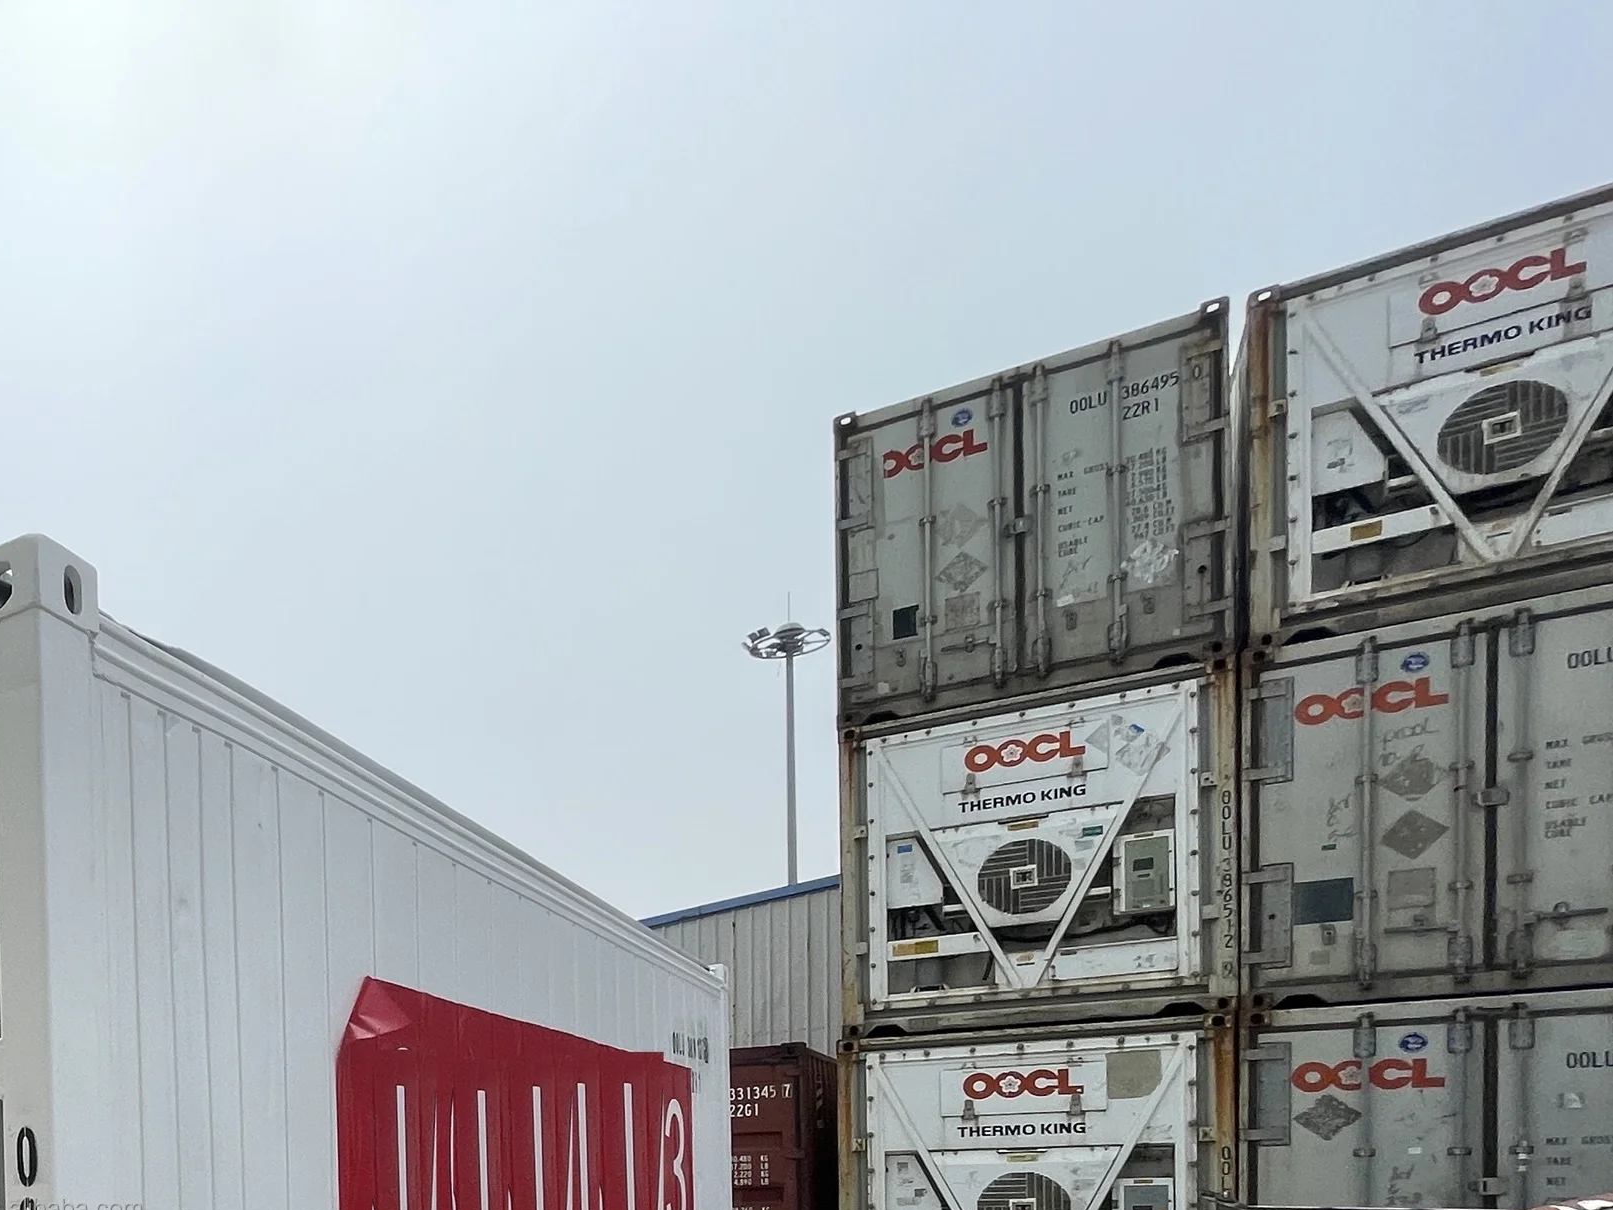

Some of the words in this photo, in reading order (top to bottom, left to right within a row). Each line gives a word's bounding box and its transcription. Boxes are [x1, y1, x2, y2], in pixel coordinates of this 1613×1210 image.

[1418, 247, 1587, 315] OOCL
[1414, 325, 1521, 364] THERMO
[1529, 306, 1592, 334] KING
[1122, 371, 1180, 400] 386495
[1122, 398, 1160, 421] 22R1
[1295, 677, 1449, 725] OOCL
[964, 730, 1086, 772] OOCL
[958, 792, 1036, 813] THERMO
[1041, 784, 1086, 802] KING
[1220, 858, 1233, 948] 386512
[963, 1068, 1085, 1099] OOCL
[1292, 1058, 1446, 1092] OOCL
[957, 1124, 1036, 1138] THERMO
[1041, 1122, 1086, 1135] KING
